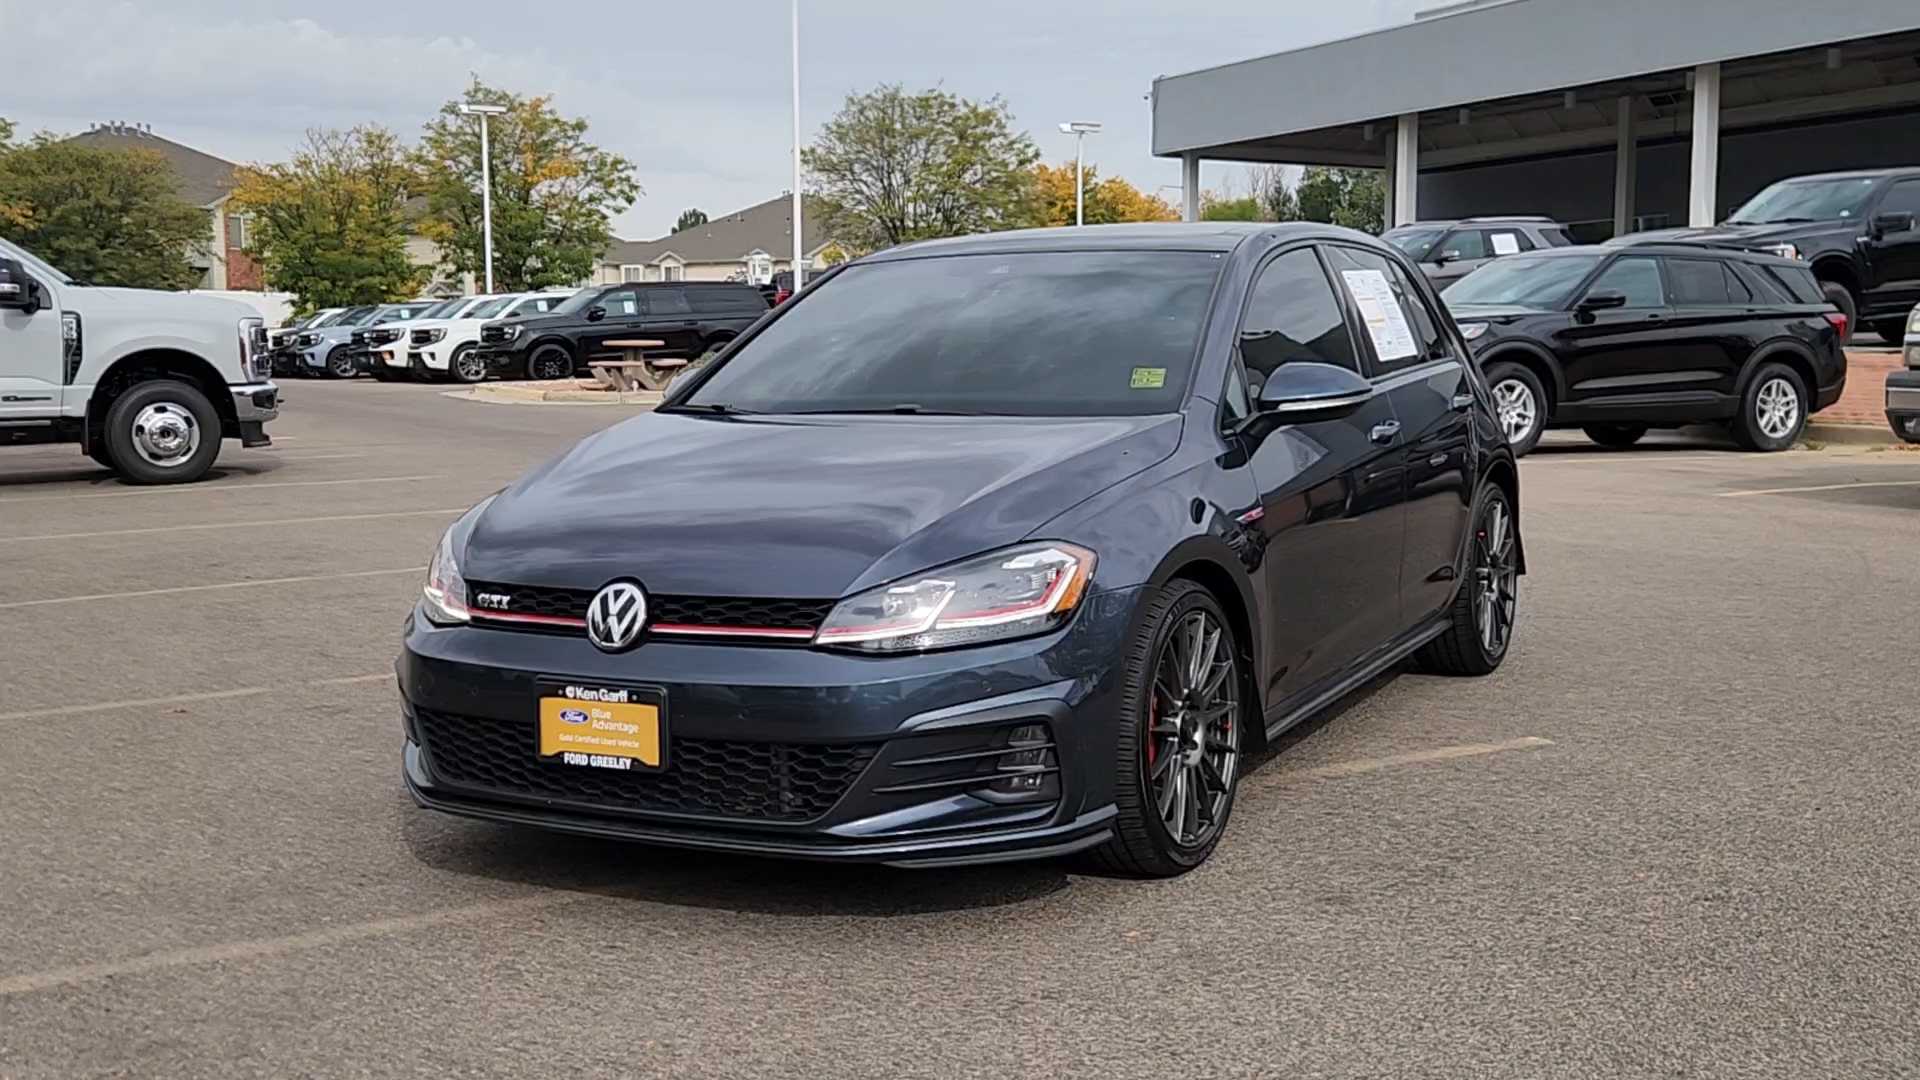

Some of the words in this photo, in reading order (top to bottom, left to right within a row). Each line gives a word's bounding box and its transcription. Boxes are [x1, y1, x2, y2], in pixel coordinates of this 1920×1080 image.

[476, 593, 511, 609] GTI
[576, 686, 598, 700] Ken
[599, 689, 628, 702] Garff
[591, 708, 611, 719] Blue
[591, 720, 639, 734] Advantage
[563, 752, 588, 766] FORD
[590, 755, 632, 770] GREELEY
